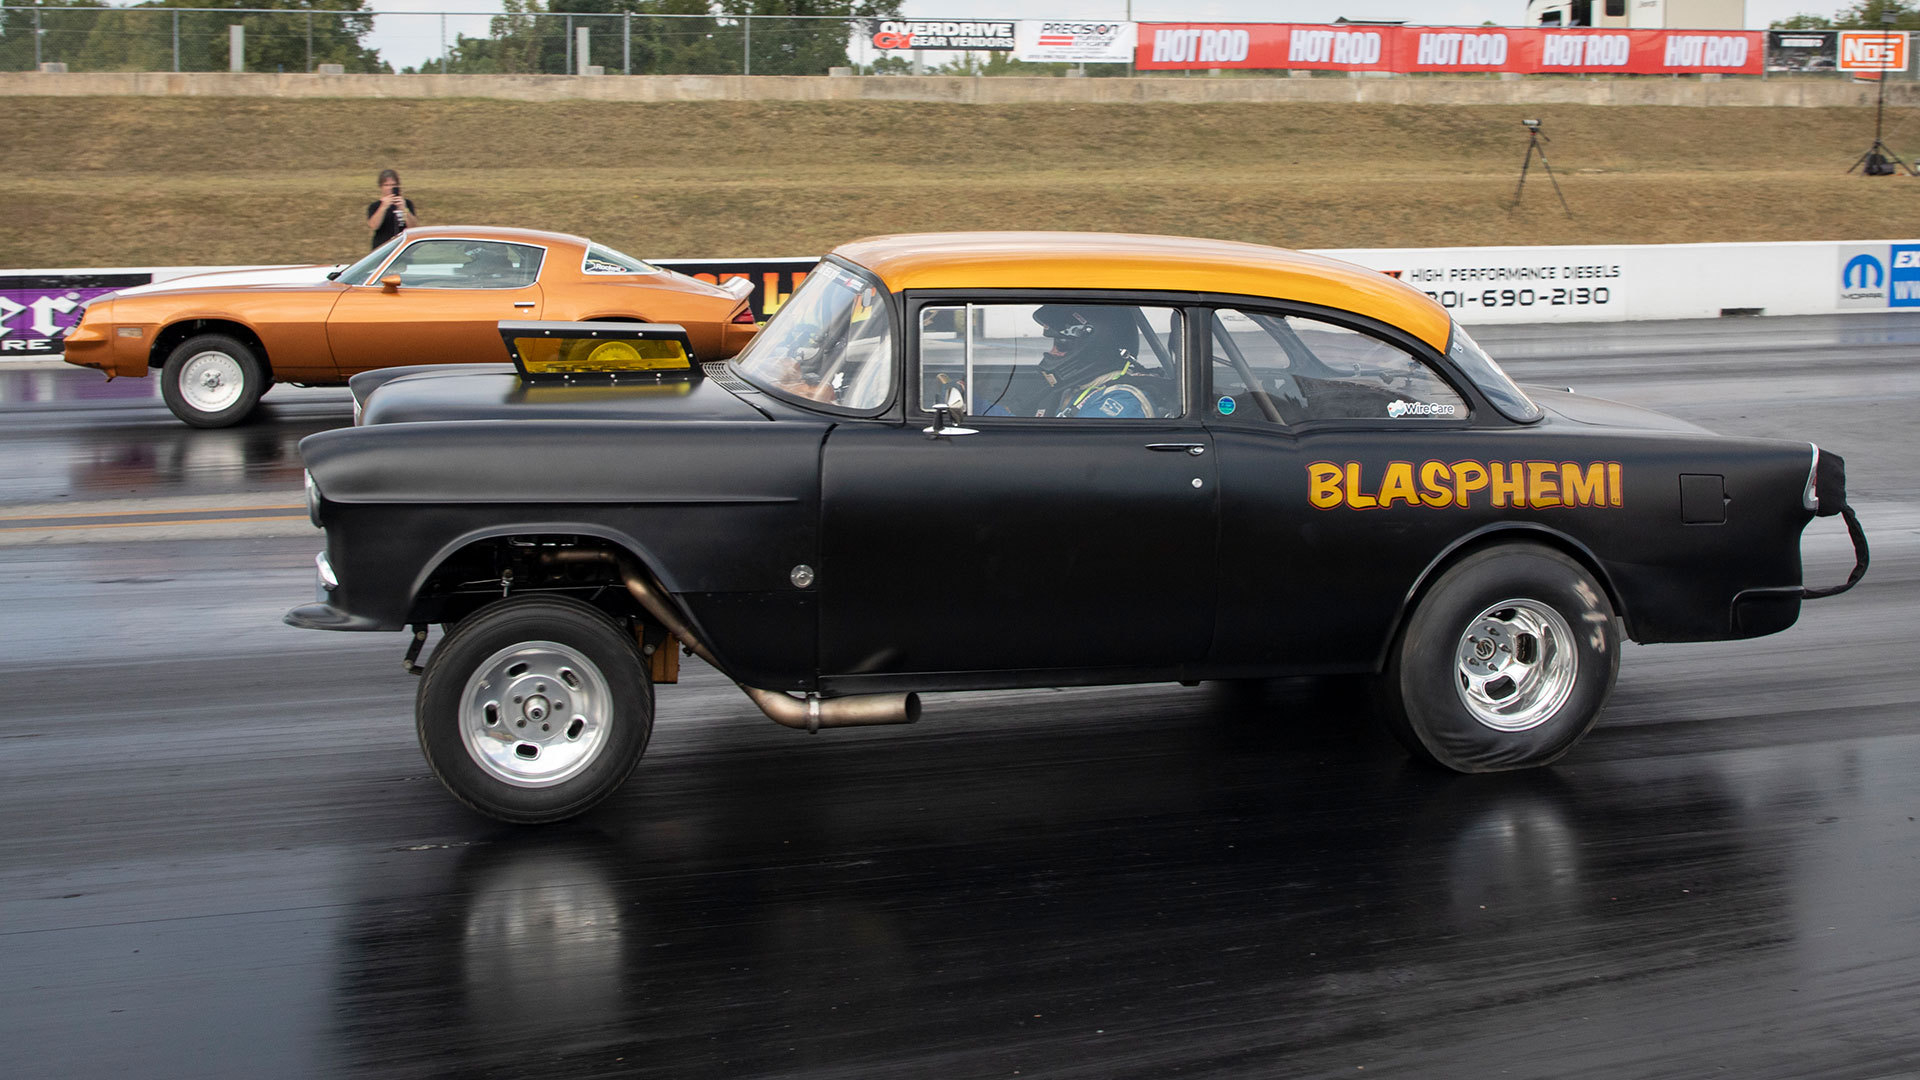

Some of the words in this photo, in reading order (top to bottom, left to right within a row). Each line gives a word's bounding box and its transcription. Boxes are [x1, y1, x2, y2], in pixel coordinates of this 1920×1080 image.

[880, 21, 1013, 36] OVERDRIVE
[1041, 22, 1119, 34] PRECISION
[909, 36, 947, 46] GEAR
[950, 37, 1014, 47] VENDORS
[1844, 38, 1902, 62] NOS
[1410, 268, 1444, 282] HIGH
[1450, 266, 1556, 281] PERFORMANCE
[1563, 265, 1621, 279] DIESELS
[2, 339, 52, 350] RE
[1405, 402, 1454, 415] WireCare
[1306, 459, 1624, 509] BLASPHEMI
